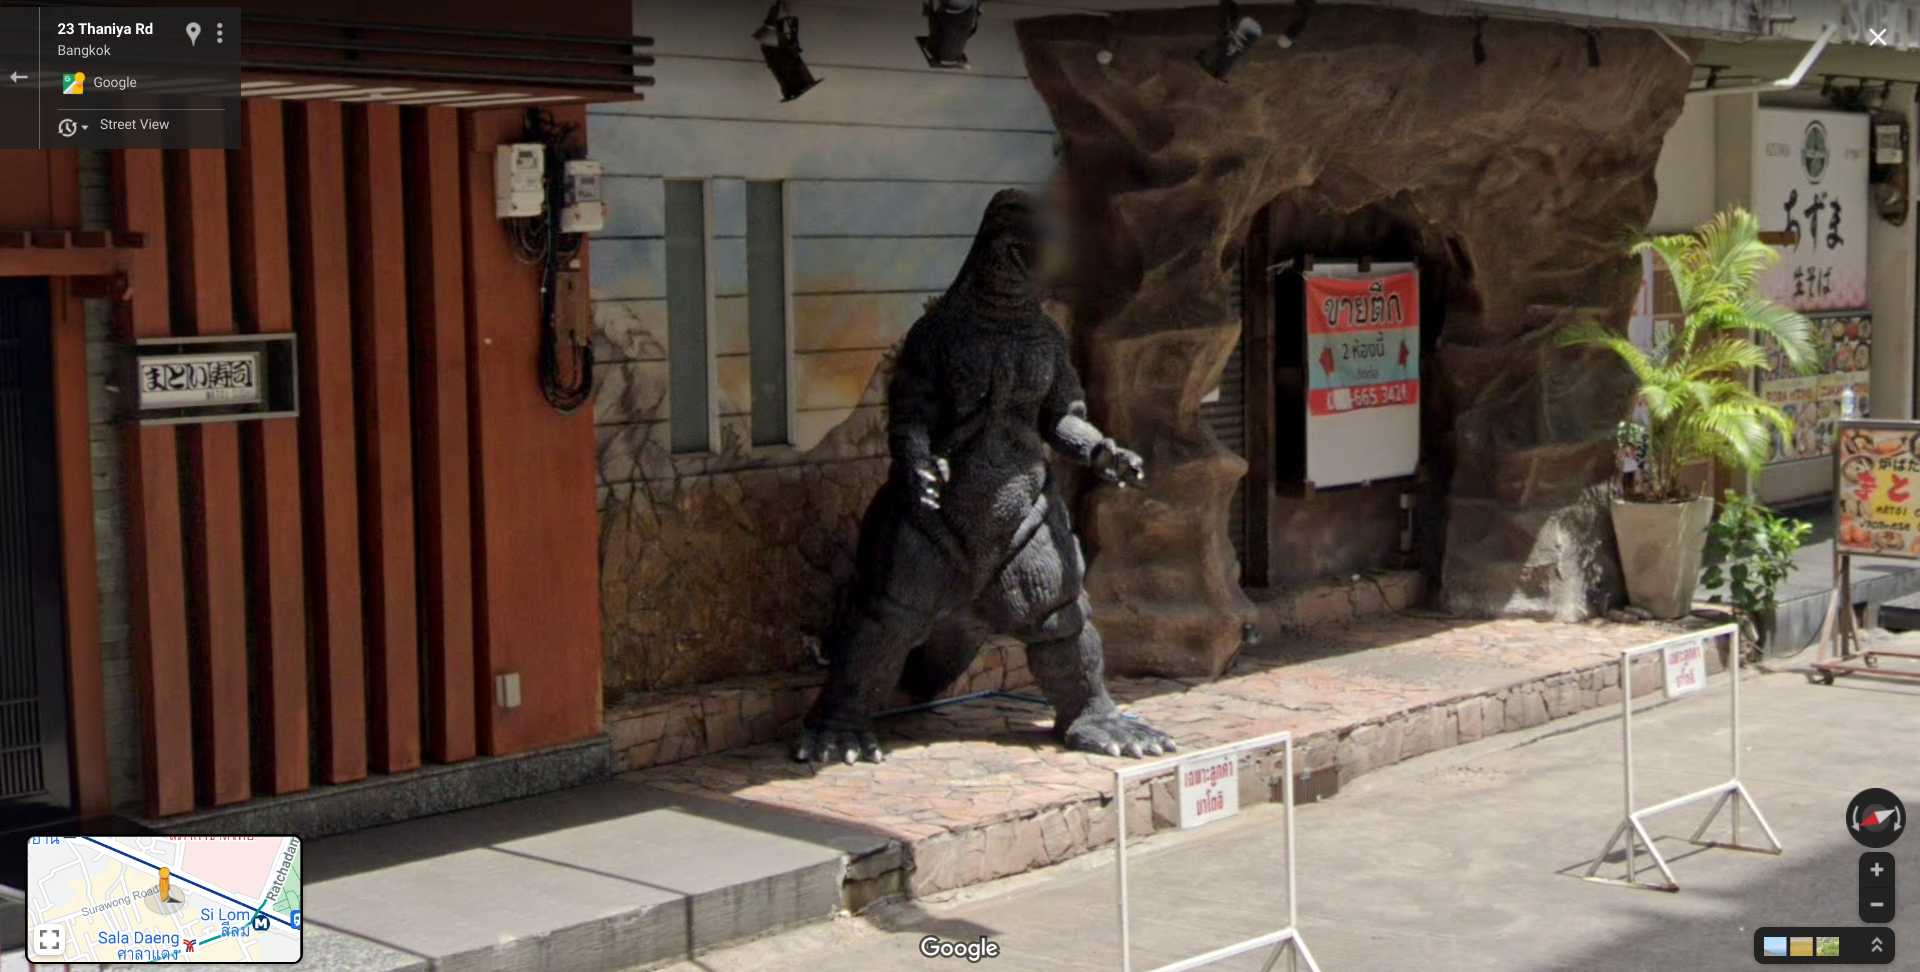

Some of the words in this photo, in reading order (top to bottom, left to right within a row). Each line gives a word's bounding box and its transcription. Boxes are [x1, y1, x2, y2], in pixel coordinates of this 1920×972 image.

[1323, 282, 1402, 327] ขายตึก
[1342, 342, 1349, 360] 2
[144, 360, 253, 390] まとい寿司
